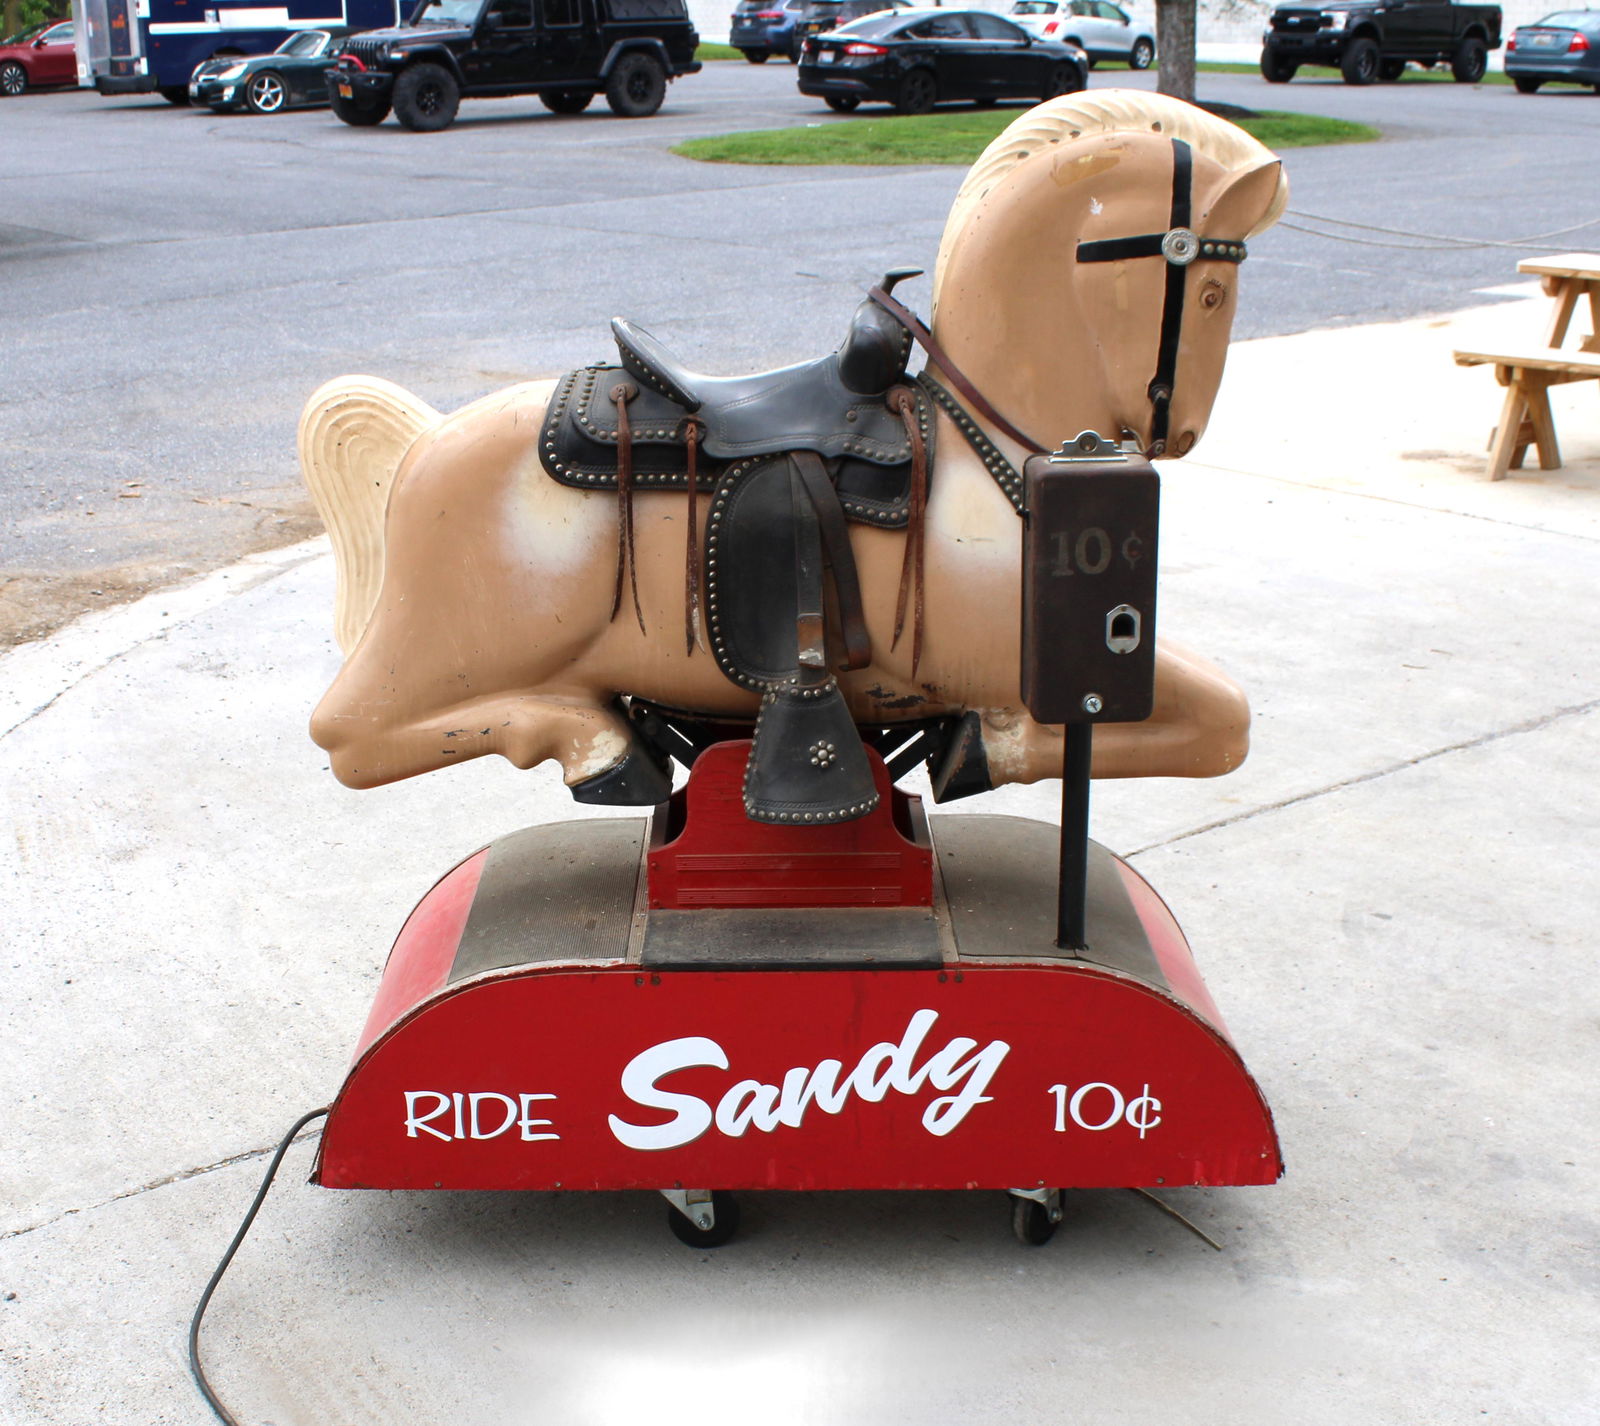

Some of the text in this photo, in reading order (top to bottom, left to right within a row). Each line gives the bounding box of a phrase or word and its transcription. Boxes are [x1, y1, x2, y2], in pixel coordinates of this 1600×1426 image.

[403, 1008, 1163, 1151] RIDE Sandy 10¢
